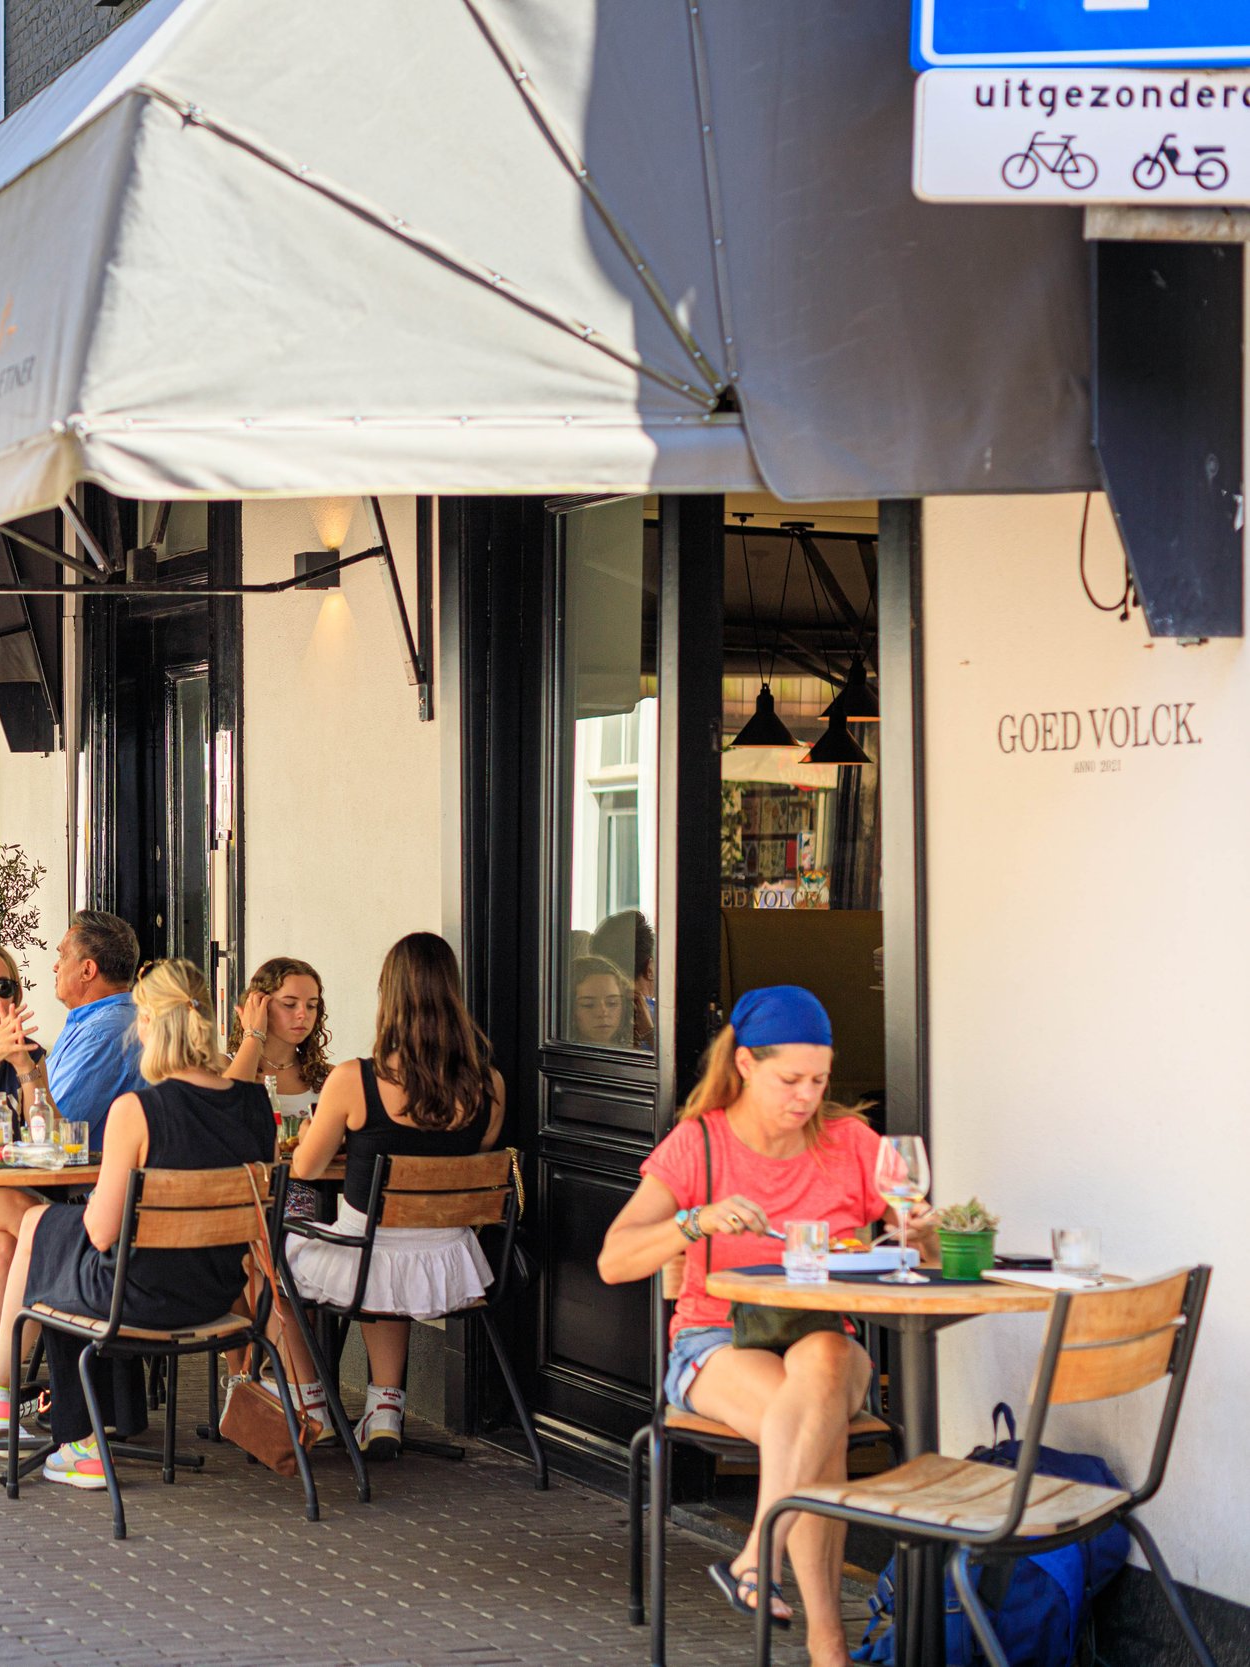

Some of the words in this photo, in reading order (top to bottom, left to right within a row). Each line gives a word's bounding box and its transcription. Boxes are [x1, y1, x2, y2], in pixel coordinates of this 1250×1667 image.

[997, 710, 1082, 754] GOED
[1088, 702, 1203, 750] VOLCK.
[1073, 760, 1096, 774] ANNO
[1100, 759, 1122, 773] 2021
